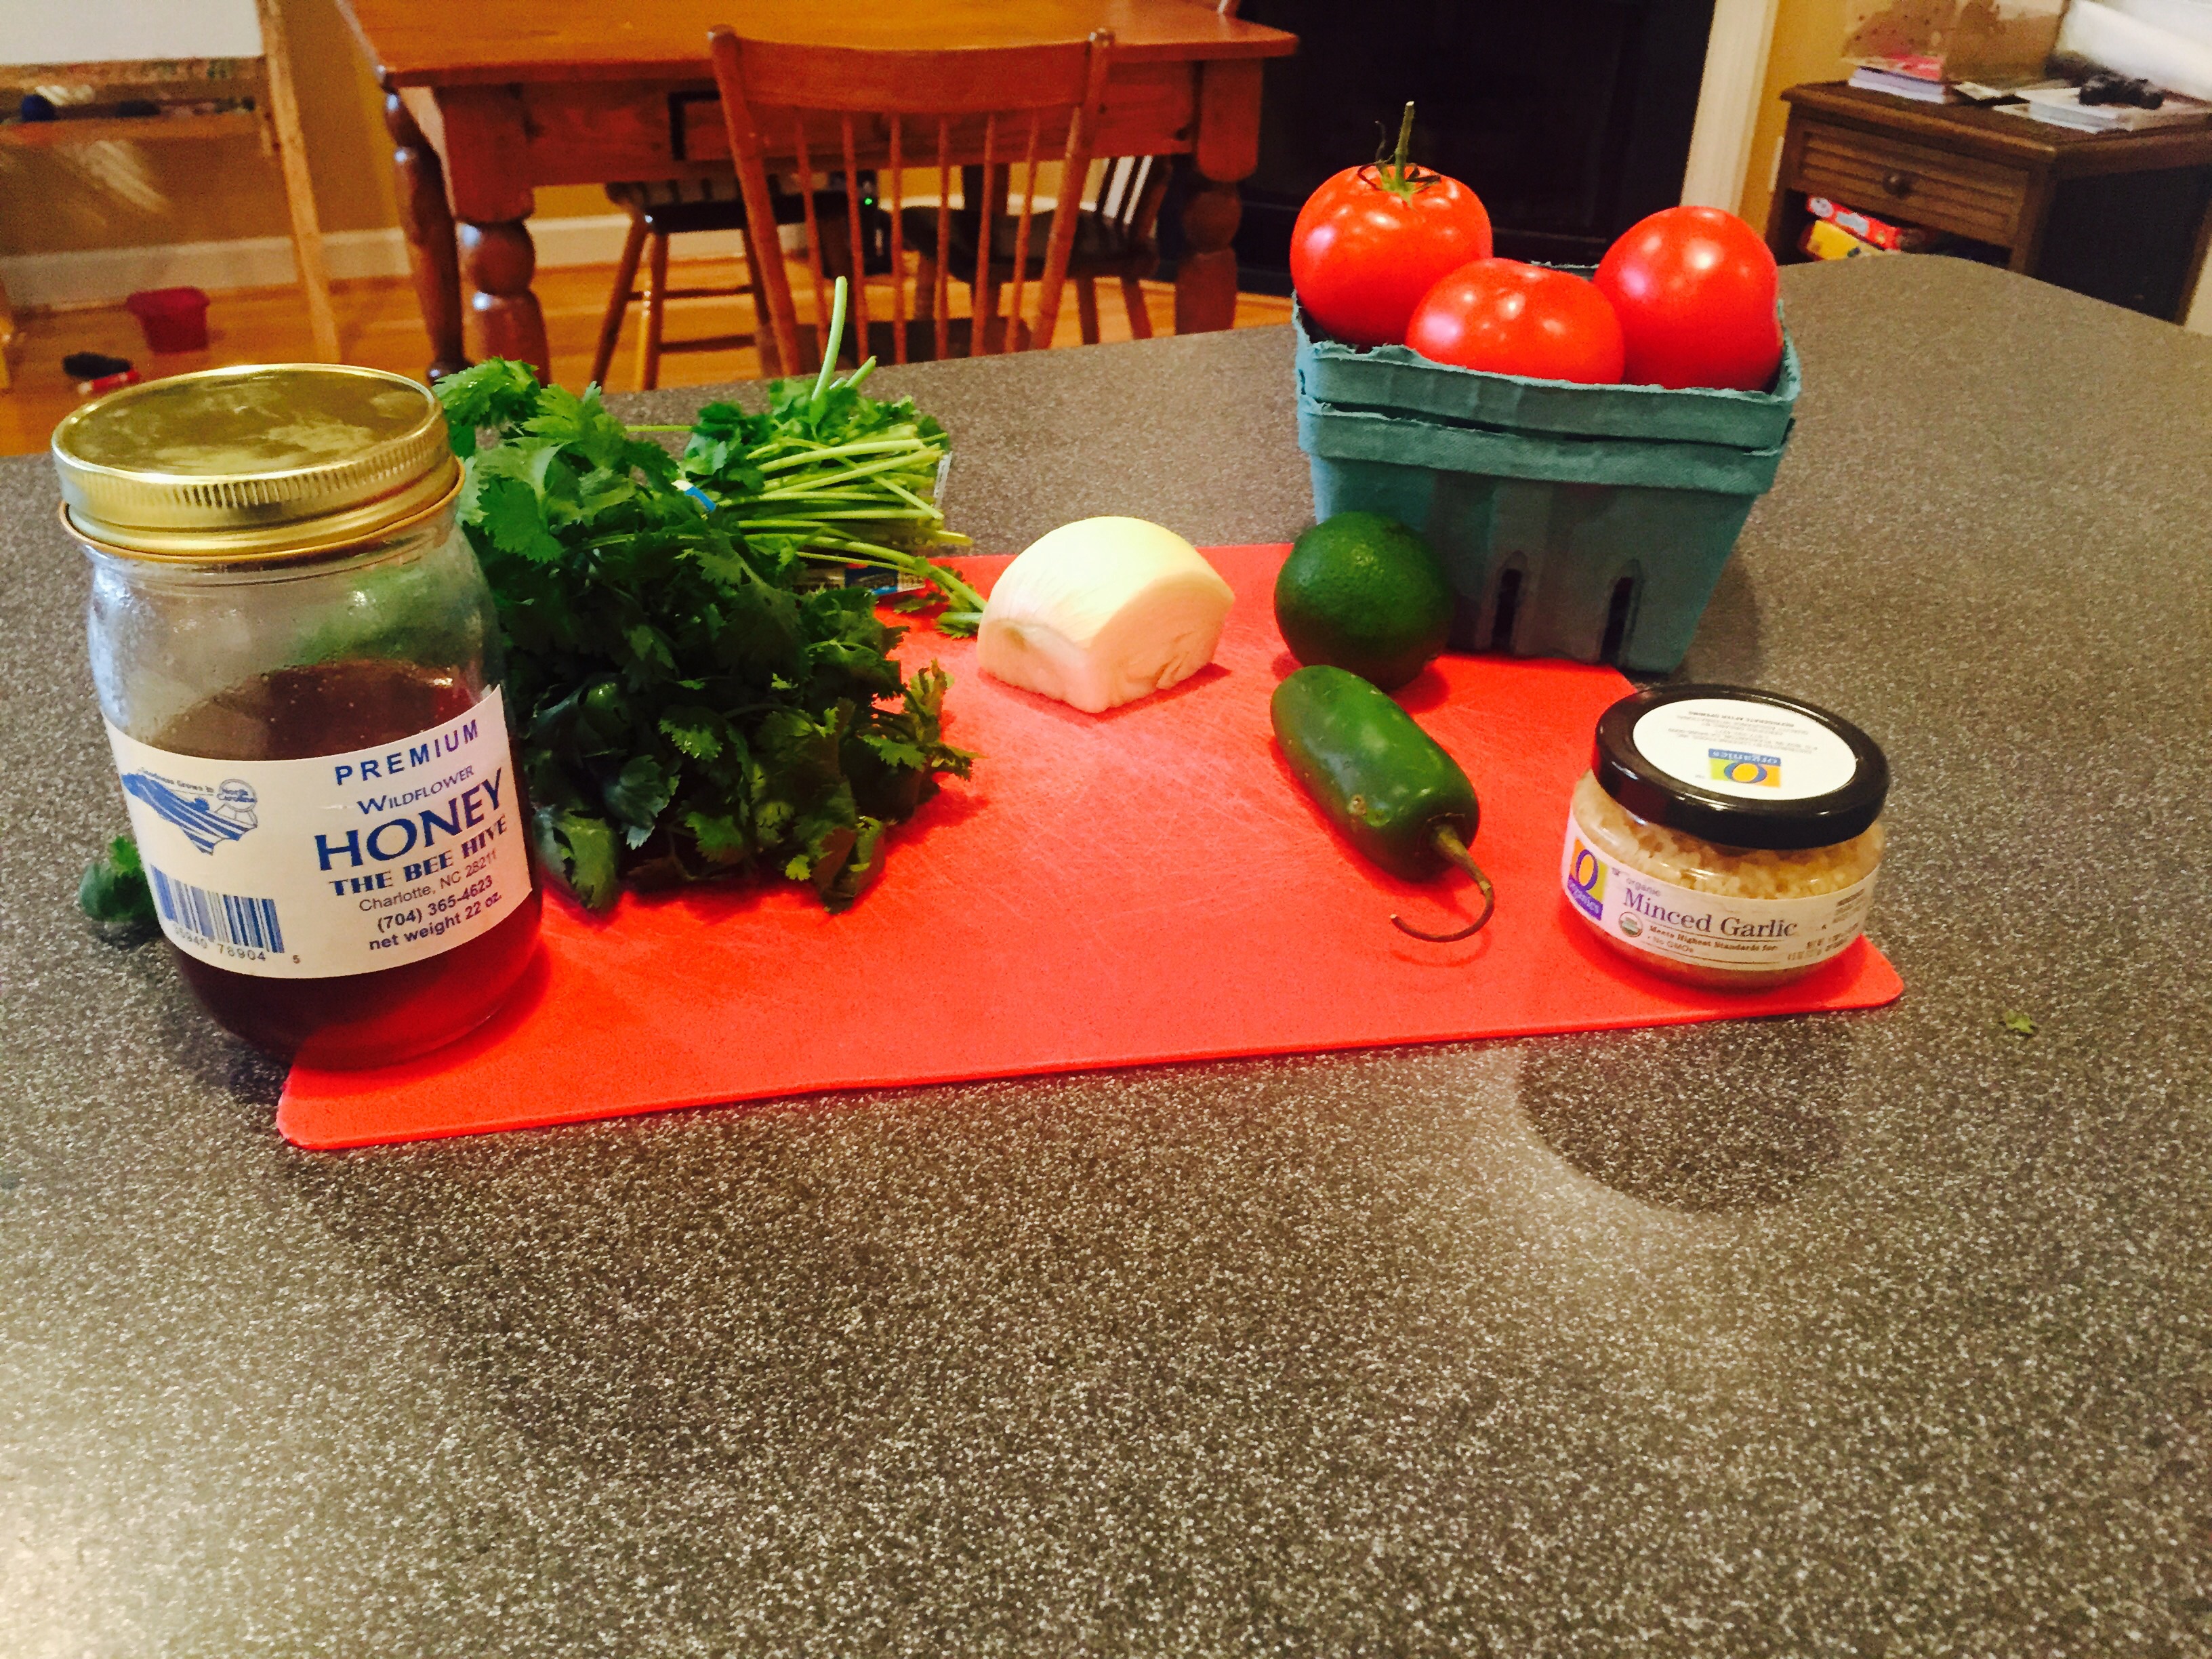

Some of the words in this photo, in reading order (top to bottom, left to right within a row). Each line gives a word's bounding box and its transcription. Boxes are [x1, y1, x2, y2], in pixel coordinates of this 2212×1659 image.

[335, 719, 478, 785] PREMIUM
[314, 766, 502, 872] HONEY
[356, 765, 474, 815] WILDFLOWER
[328, 869, 394, 897] THE
[403, 849, 454, 882] BEE
[461, 815, 508, 859] HIVE
[359, 884, 436, 912] Charlotte,
[441, 870, 462, 890] NC
[465, 848, 497, 878] 28211
[369, 934, 398, 951] net
[403, 912, 462, 942] weight
[465, 900, 482, 920] 22
[485, 890, 503, 907] oz.
[377, 907, 423, 934] (704)
[428, 874, 493, 916] 365-4623
[1622, 887, 1713, 933] Minced
[1720, 916, 1798, 938] Garlic
